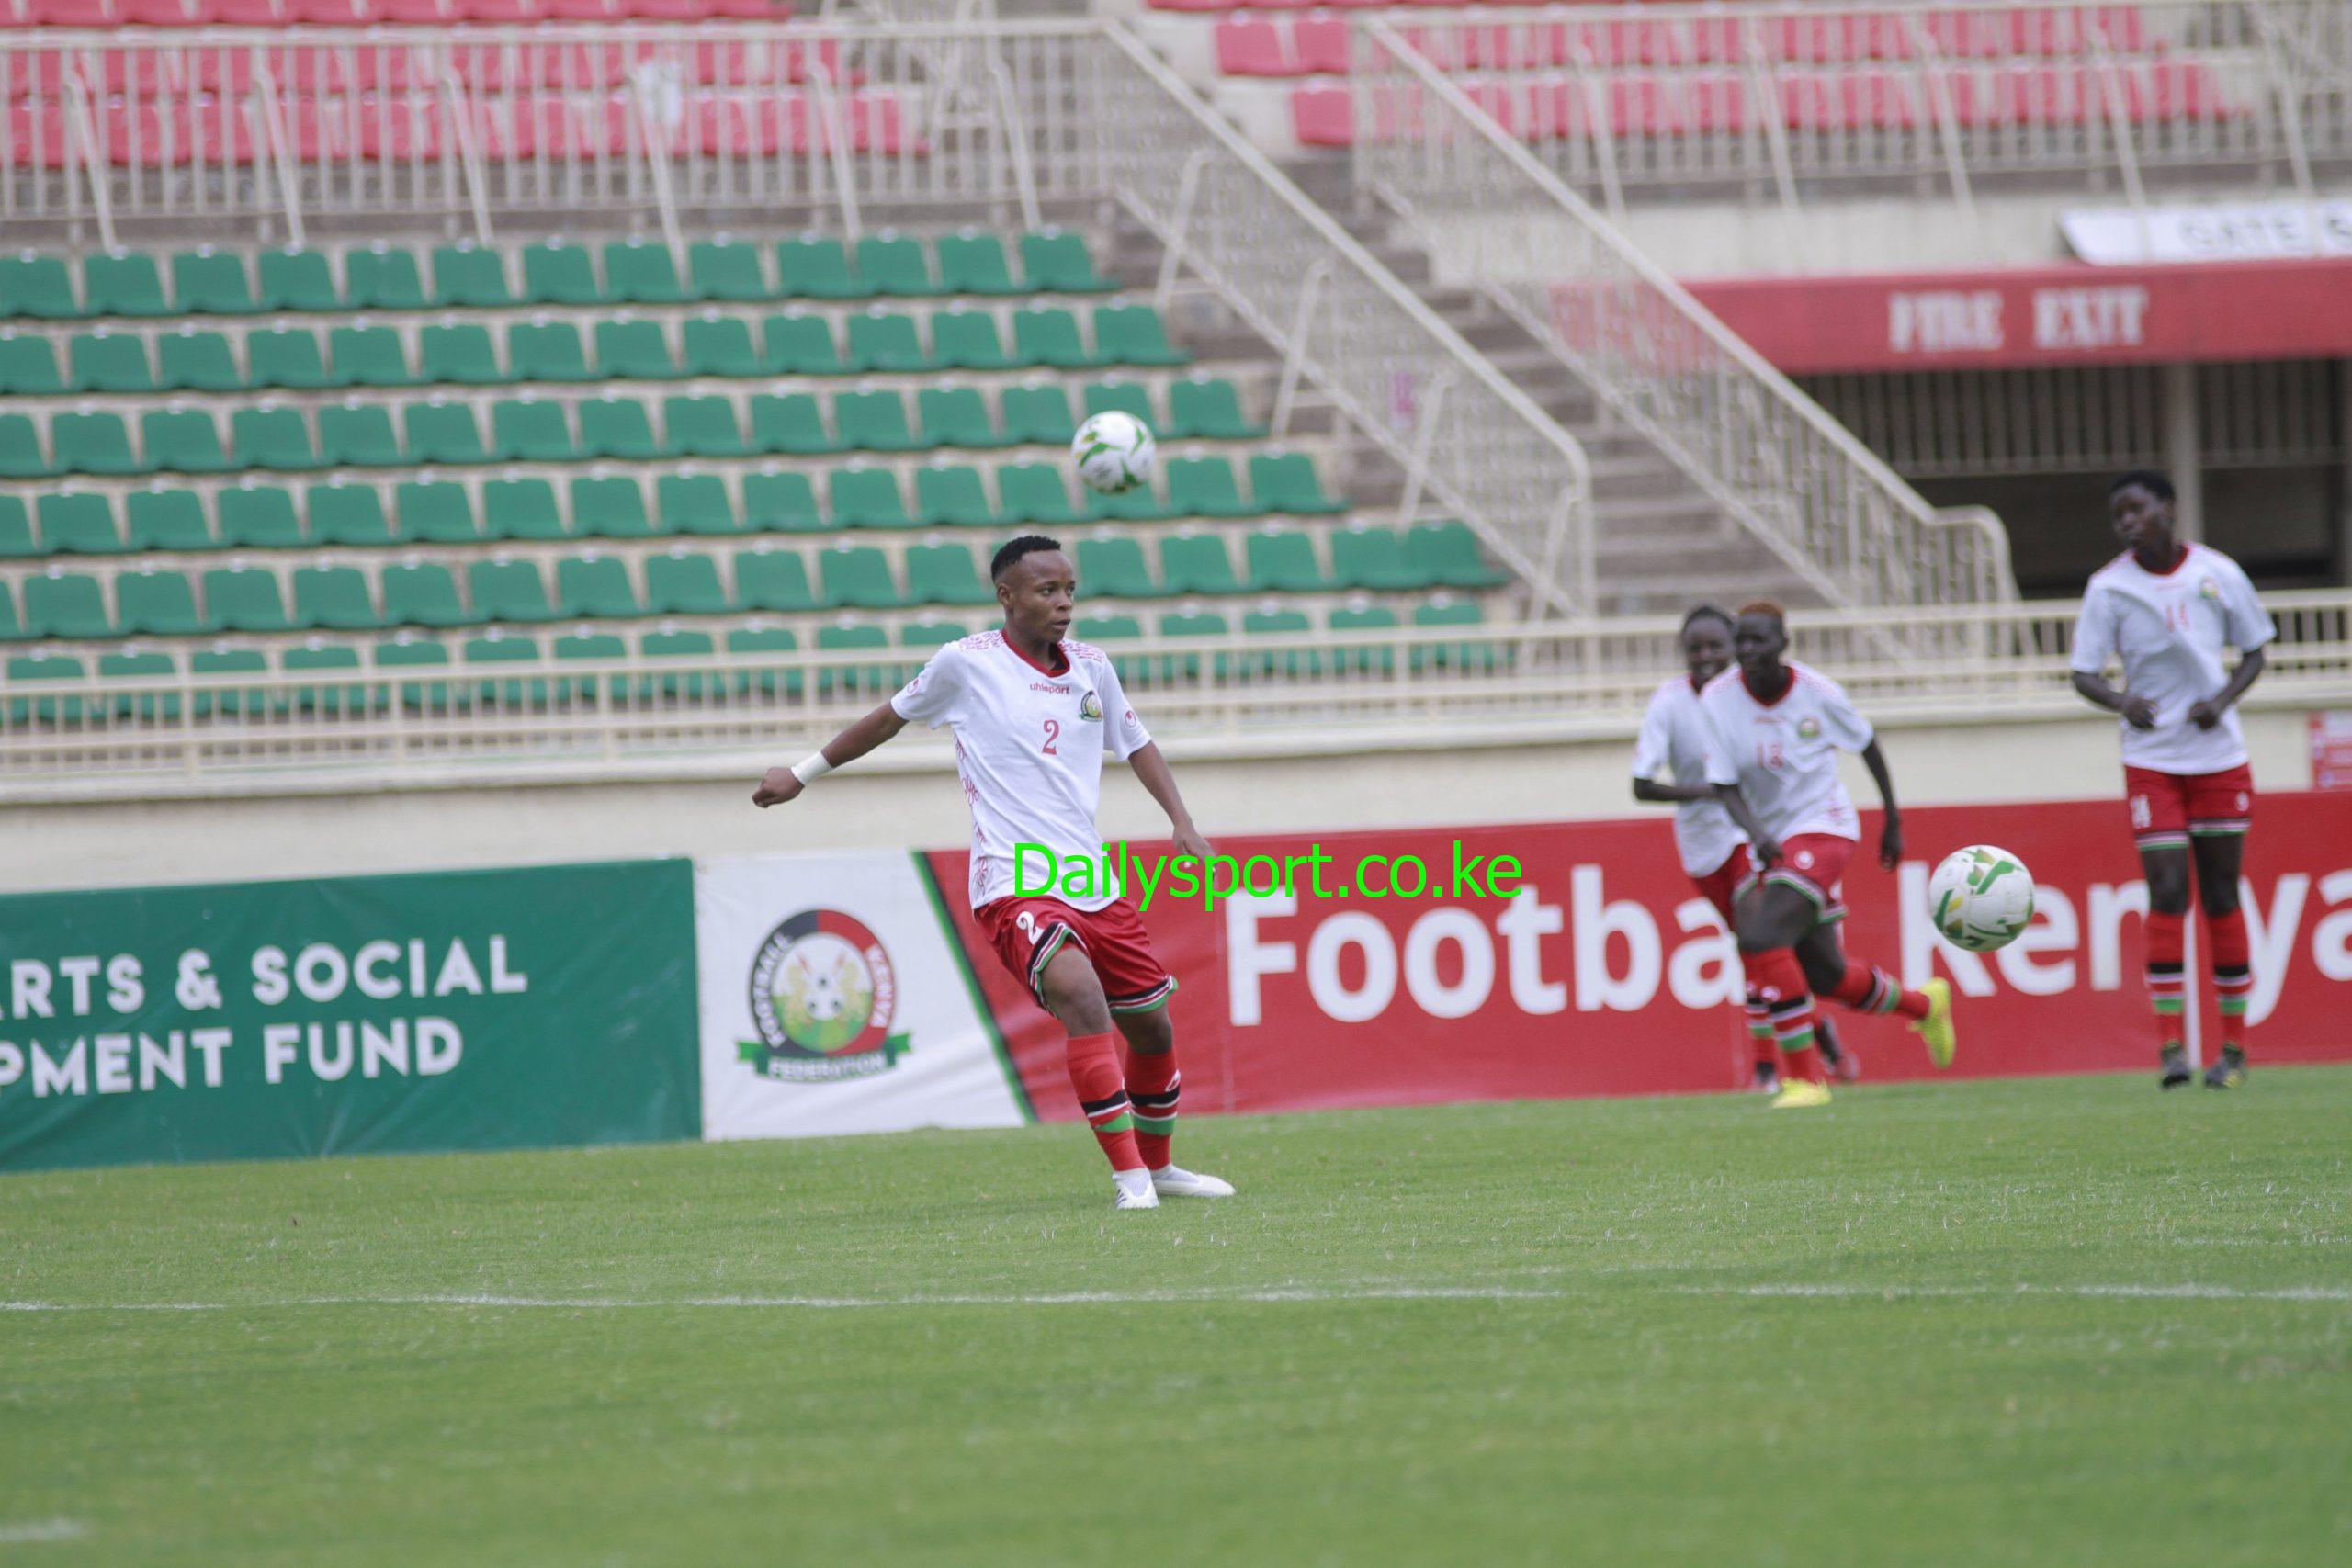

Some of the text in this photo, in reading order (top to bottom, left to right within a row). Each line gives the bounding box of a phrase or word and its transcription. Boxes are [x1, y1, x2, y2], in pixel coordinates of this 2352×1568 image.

[1888, 286, 2147, 353] FIRE EXIT
[1030, 682, 1070, 694] uhlsport
[1042, 719, 1060, 755] 2
[1016, 910, 1044, 945] 2
[1225, 863, 1841, 1027] Footba
[0, 934, 528, 1021] RTS & SOCIAL
[263, 1016, 463, 1085] FUND
